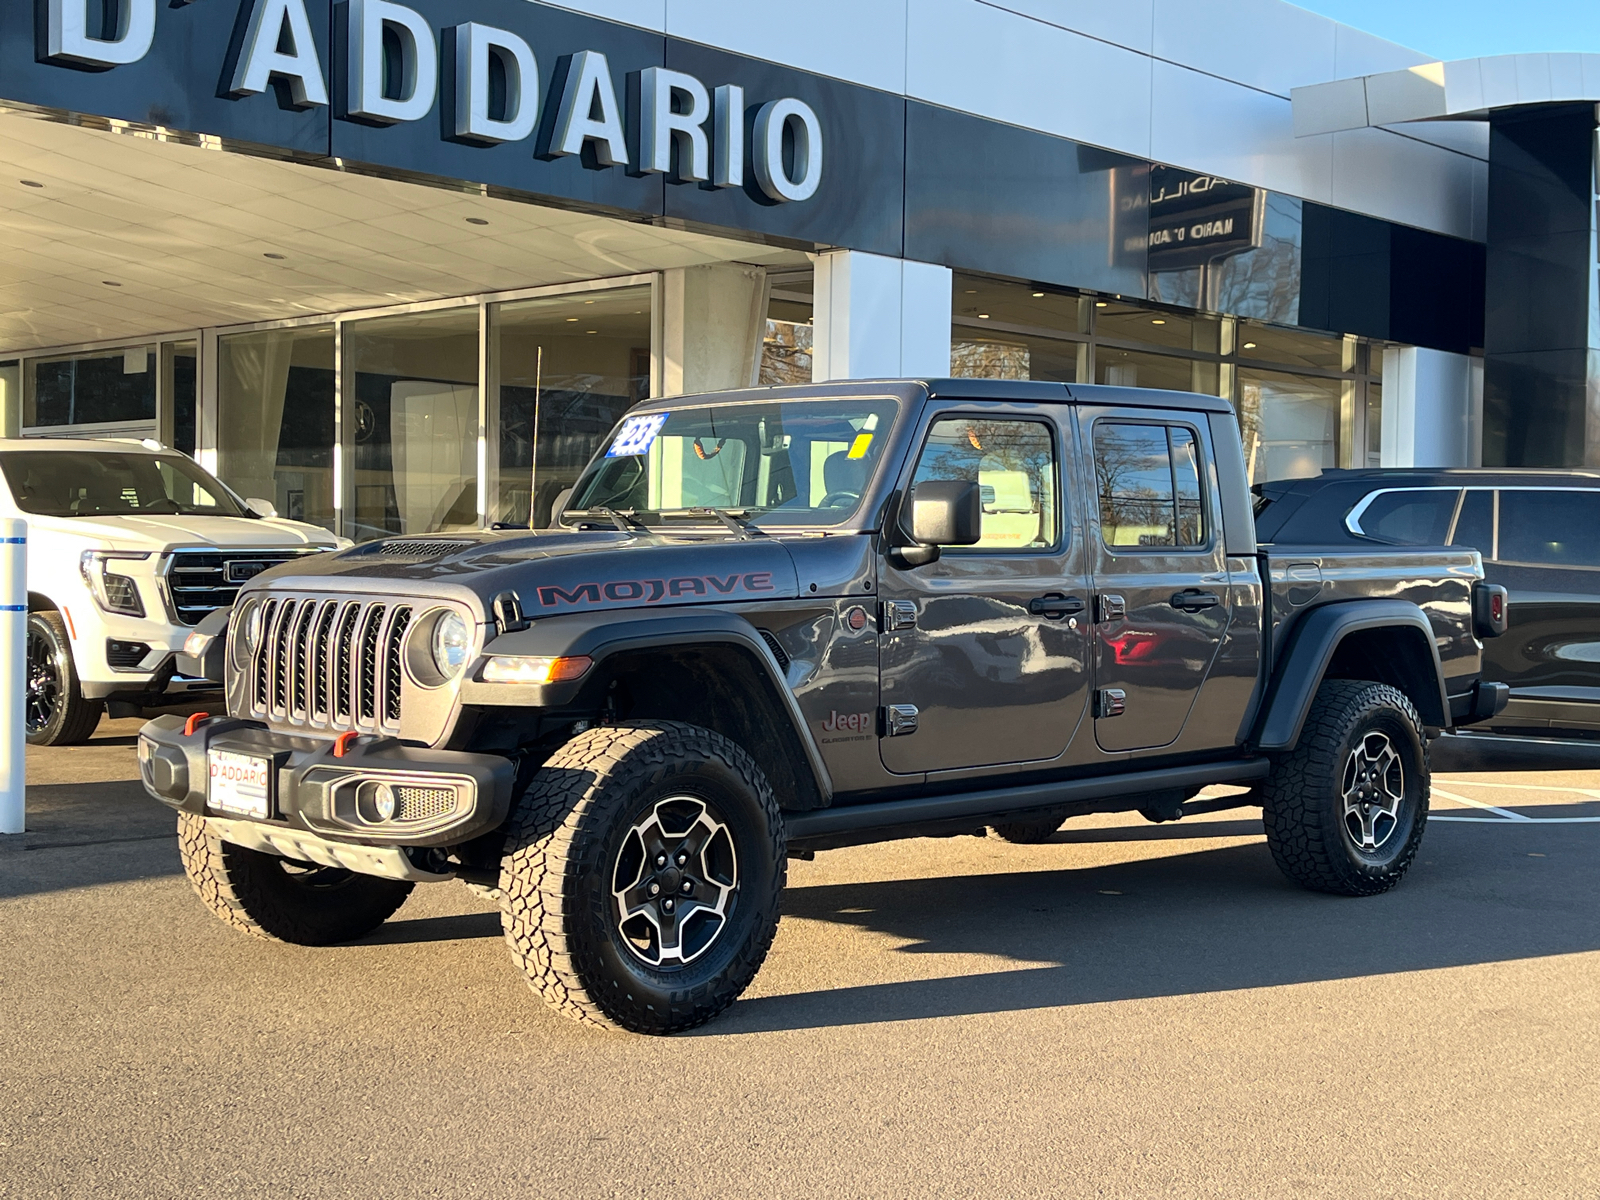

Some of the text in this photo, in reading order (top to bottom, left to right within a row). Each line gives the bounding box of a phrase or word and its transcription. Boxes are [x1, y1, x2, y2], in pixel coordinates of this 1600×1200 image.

[46, 0, 824, 202] ADDARIO
[621, 422, 652, 447] 23
[537, 572, 774, 607] MOJAVE
[821, 709, 870, 734] Jeep
[821, 735, 865, 744] GLADIATOR
